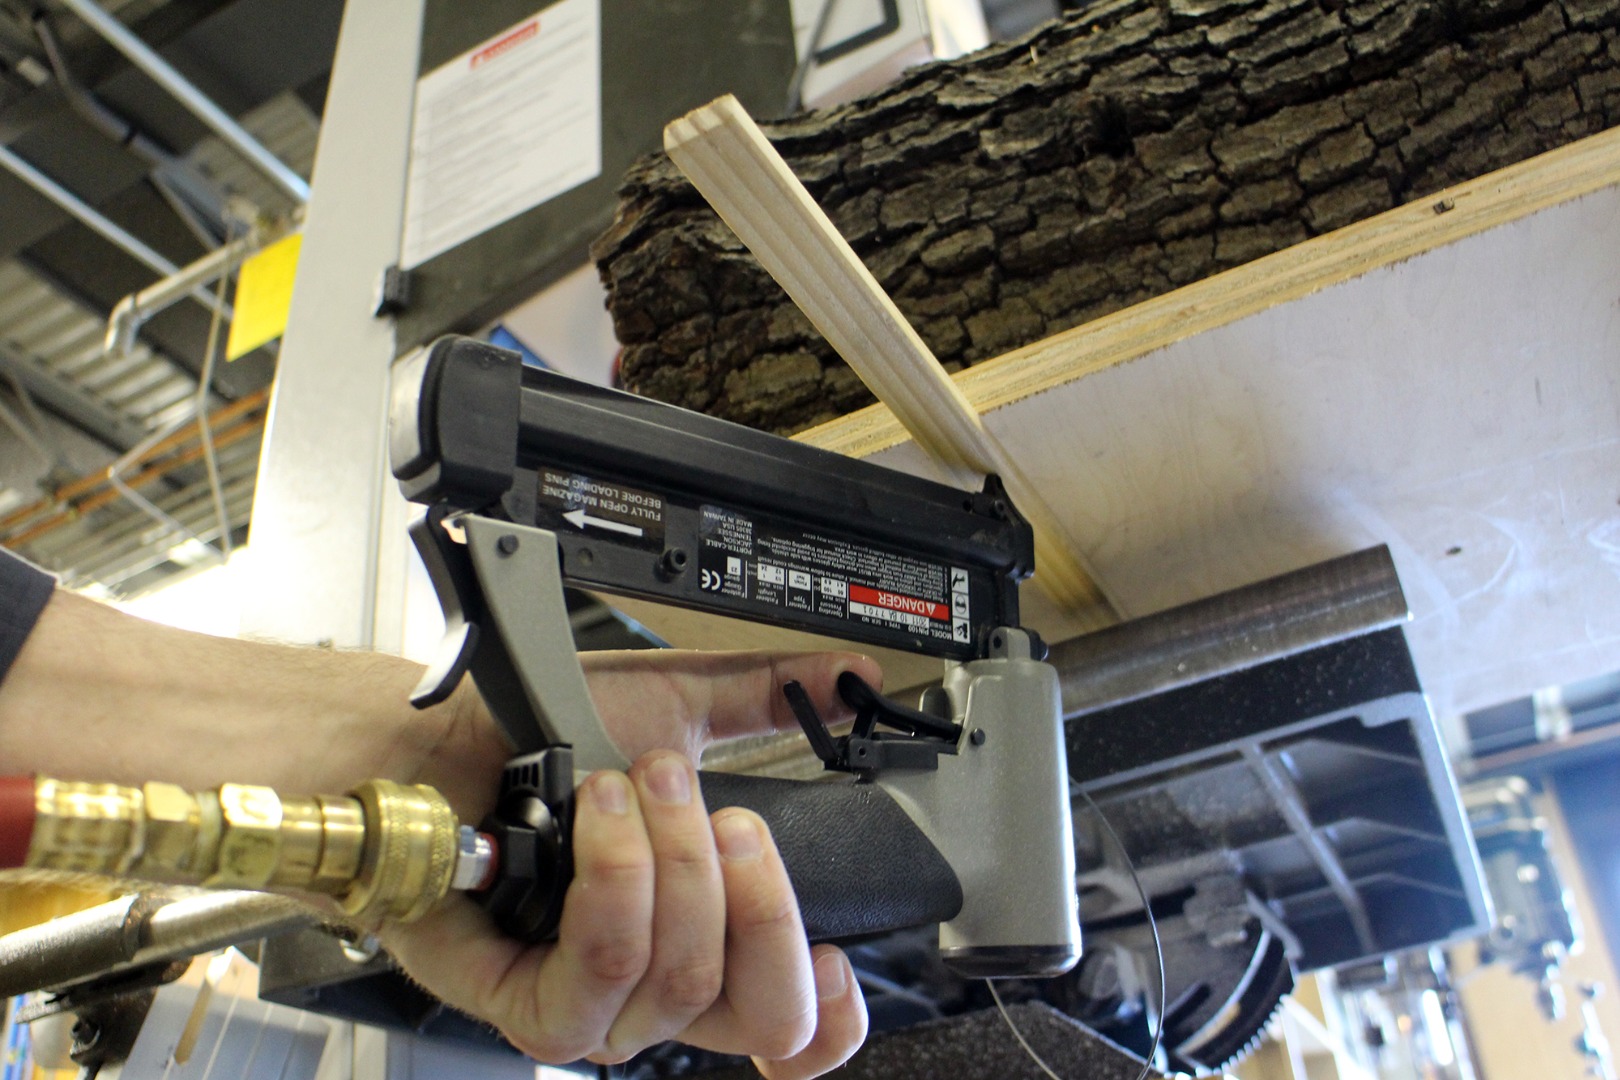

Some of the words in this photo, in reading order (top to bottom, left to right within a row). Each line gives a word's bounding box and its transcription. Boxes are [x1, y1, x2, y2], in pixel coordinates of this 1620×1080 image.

[545, 473, 569, 485] PINS
[572, 480, 618, 498] LOADING
[543, 485, 597, 506] MAGAZINE
[622, 492, 661, 508] BEFORE
[600, 499, 628, 513] OPEN
[632, 507, 661, 521] FULLY
[703, 511, 726, 522] TAIWAN
[728, 516, 734, 524] IN
[737, 518, 752, 528] MADE
[722, 522, 735, 531] USA
[718, 527, 752, 541] TENNESSEE
[724, 580, 742, 590] Gauge
[721, 586, 744, 598] Fastener
[758, 587, 777, 598] Length
[756, 593, 778, 604] Fastener
[793, 594, 805, 604] Type
[878, 591, 924, 614] DANGER
[788, 600, 810, 611] Fastener
[819, 600, 842, 611] Pressure
[819, 606, 843, 618] Operating
[912, 616, 926, 627] 2011
[930, 628, 952, 641] MODEL
